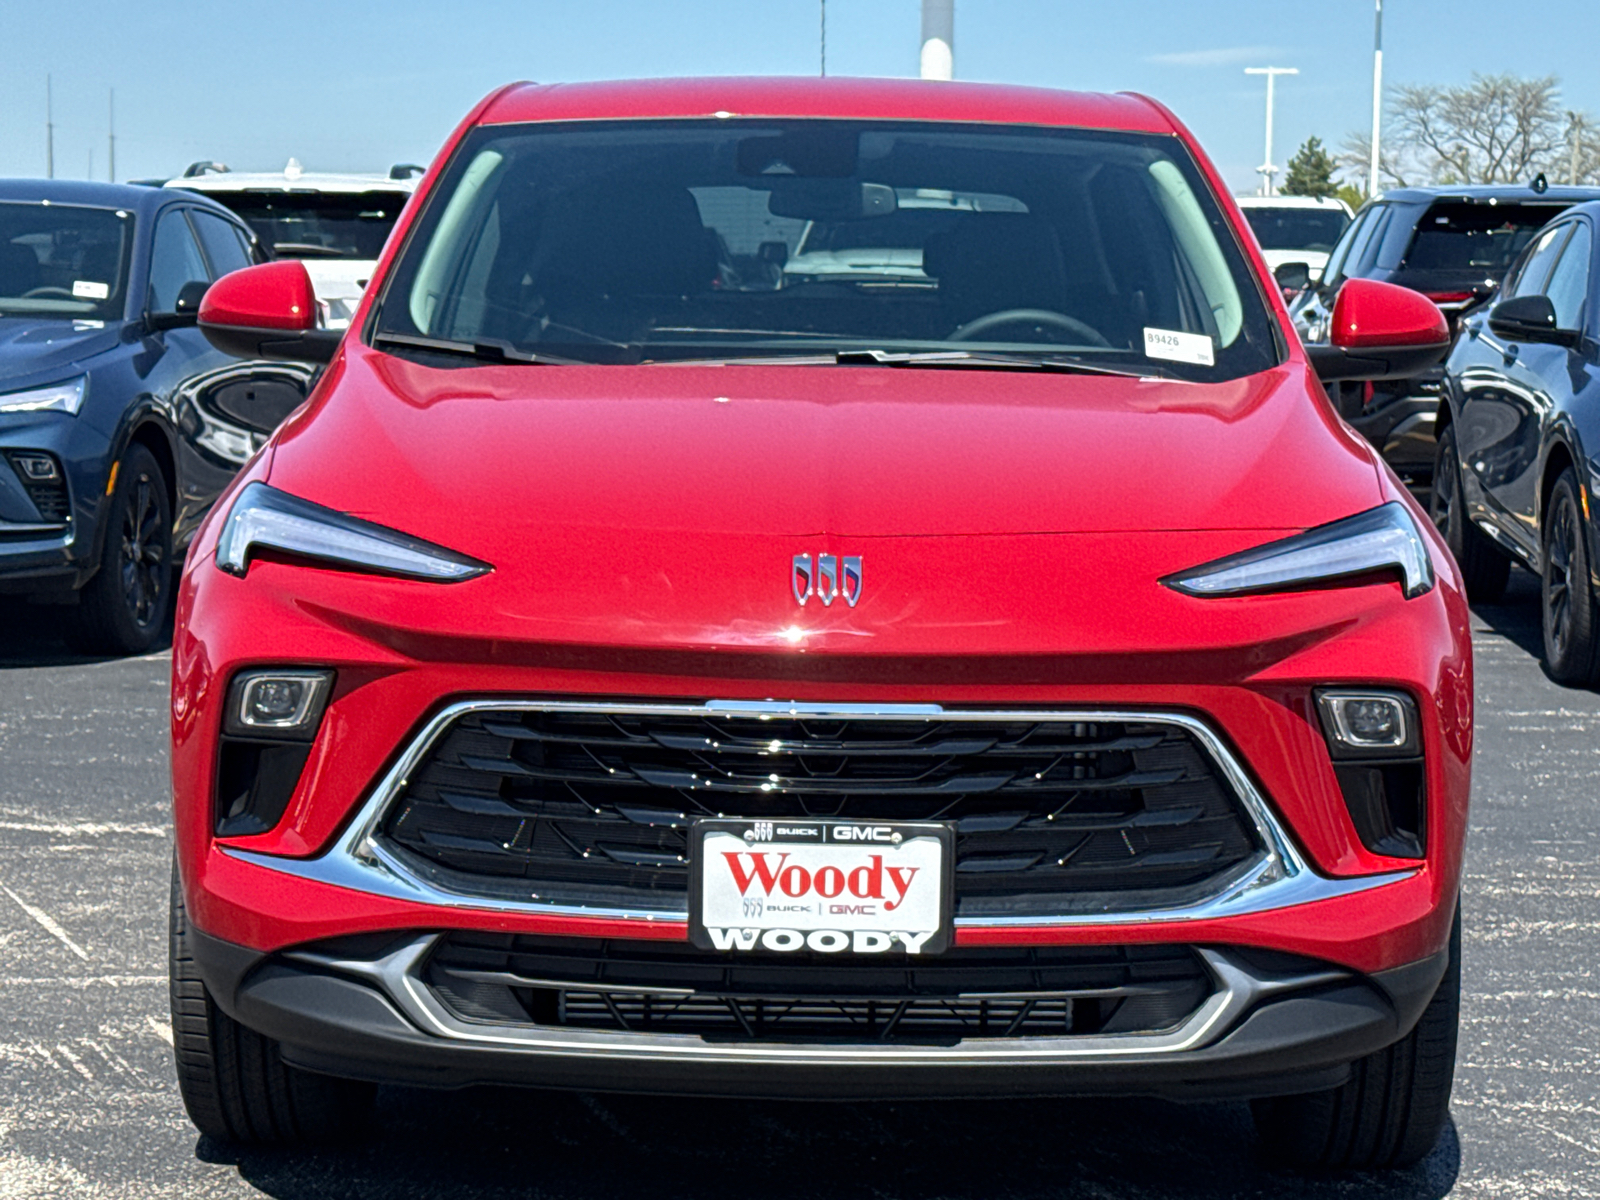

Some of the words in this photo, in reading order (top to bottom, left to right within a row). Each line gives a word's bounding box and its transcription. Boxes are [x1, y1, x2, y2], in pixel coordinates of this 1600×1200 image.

[776, 827, 818, 836] BUICK
[833, 826, 892, 841] GMC
[721, 852, 920, 911] Woody
[829, 905, 877, 916] GMC
[707, 928, 934, 954] WOODY
